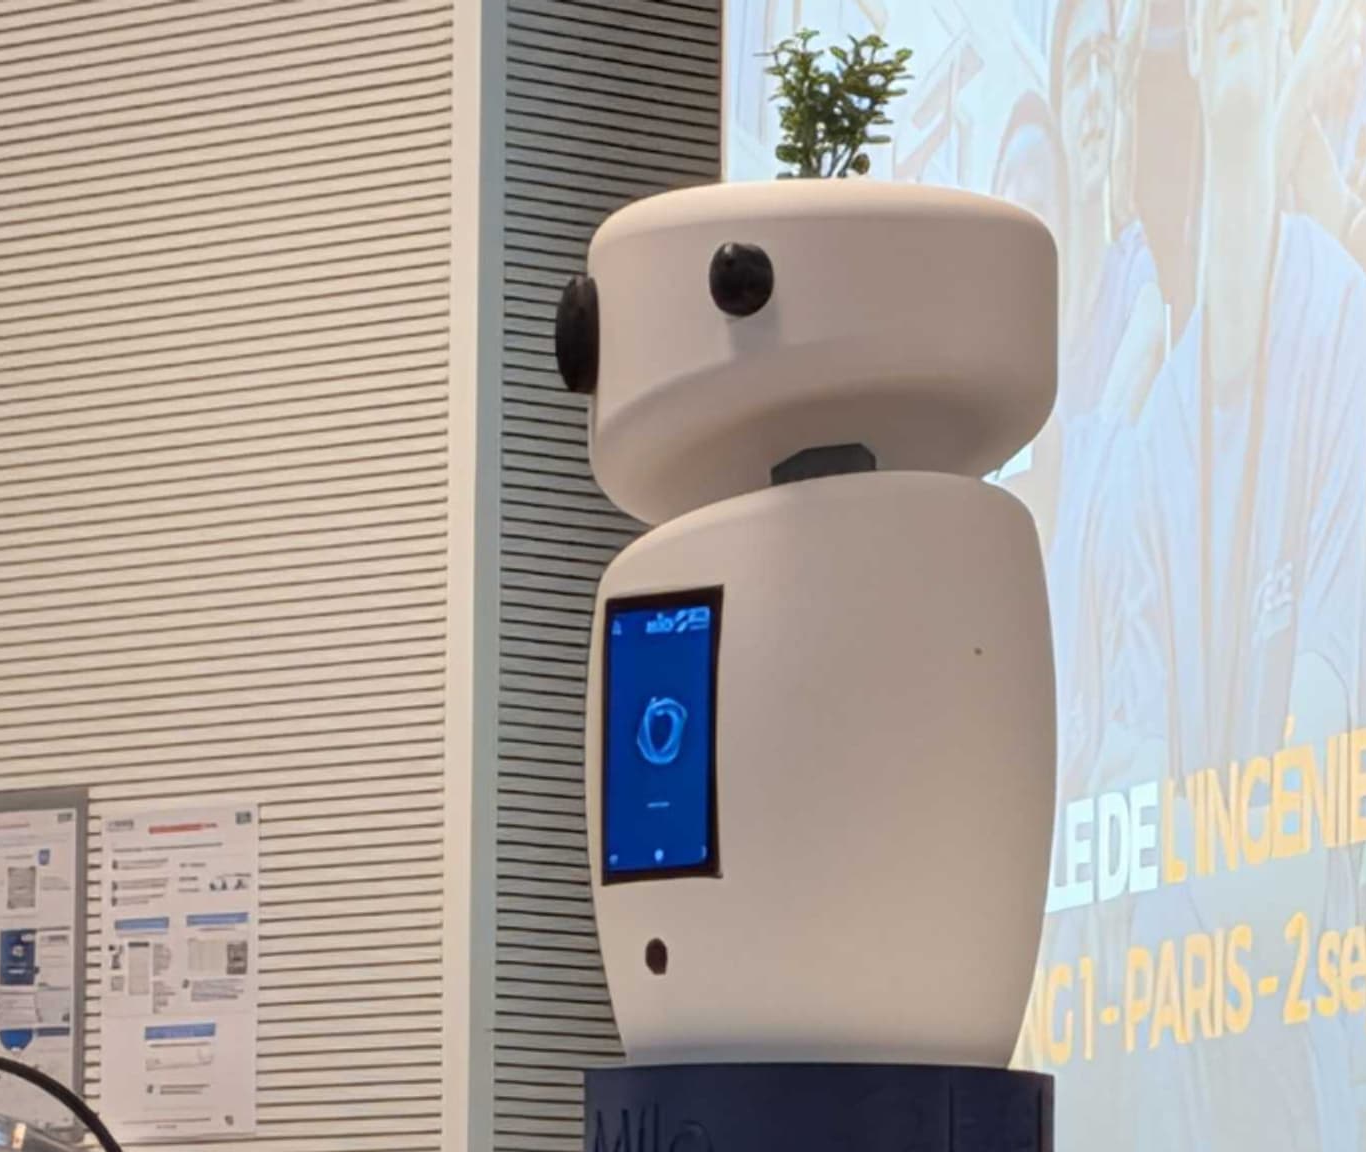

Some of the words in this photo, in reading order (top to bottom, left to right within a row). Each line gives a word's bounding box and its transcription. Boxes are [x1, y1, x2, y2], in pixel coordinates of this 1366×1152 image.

[1098, 780, 1158, 902] DE
[1124, 924, 1254, 1053] PARIS
[1282, 911, 1312, 1026] 2
